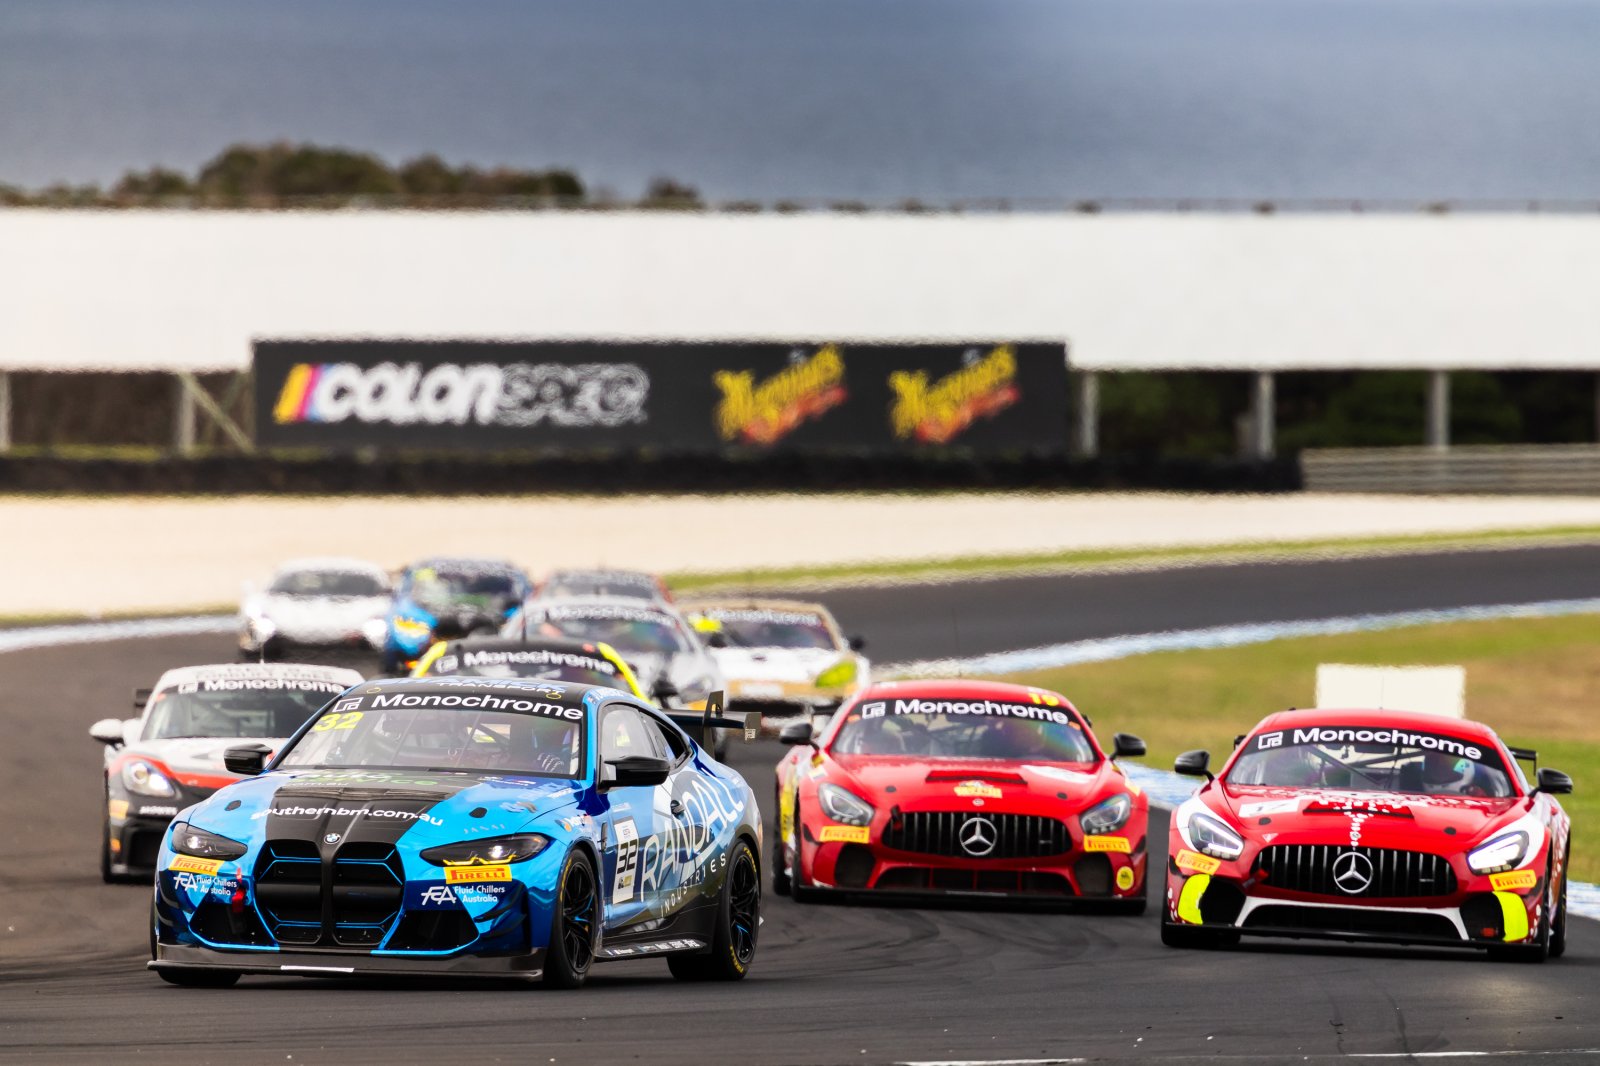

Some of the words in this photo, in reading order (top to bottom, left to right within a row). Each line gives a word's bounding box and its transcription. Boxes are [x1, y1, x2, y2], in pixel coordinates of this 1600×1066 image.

[463, 650, 616, 675] Monochrome
[203, 678, 345, 694] Monochrome
[436, 681, 566, 694] TRANSPORT
[371, 693, 584, 721] Monochrome
[894, 699, 1069, 725] Monochrome
[314, 711, 364, 731] 32
[1293, 727, 1483, 760] Monochrome
[250, 805, 444, 828] southernbm.com.au
[640, 766, 745, 903] RANDALL
[824, 829, 866, 840] PIRELLI
[1087, 839, 1129, 850] PIRELLI
[174, 857, 217, 873] PIRELLI
[616, 839, 638, 875] 32
[1179, 853, 1216, 871] PIRELLI
[196, 875, 212, 884] Fluid
[213, 877, 238, 888] Chillers
[450, 867, 506, 881] PIRELLI
[1495, 874, 1533, 888] PIRELLI
[200, 884, 232, 896] Australia
[453, 885, 474, 894] Fluid
[476, 885, 506, 894] Chillers
[660, 853, 727, 918] INDUSTRIES
[462, 894, 498, 903] Australia
